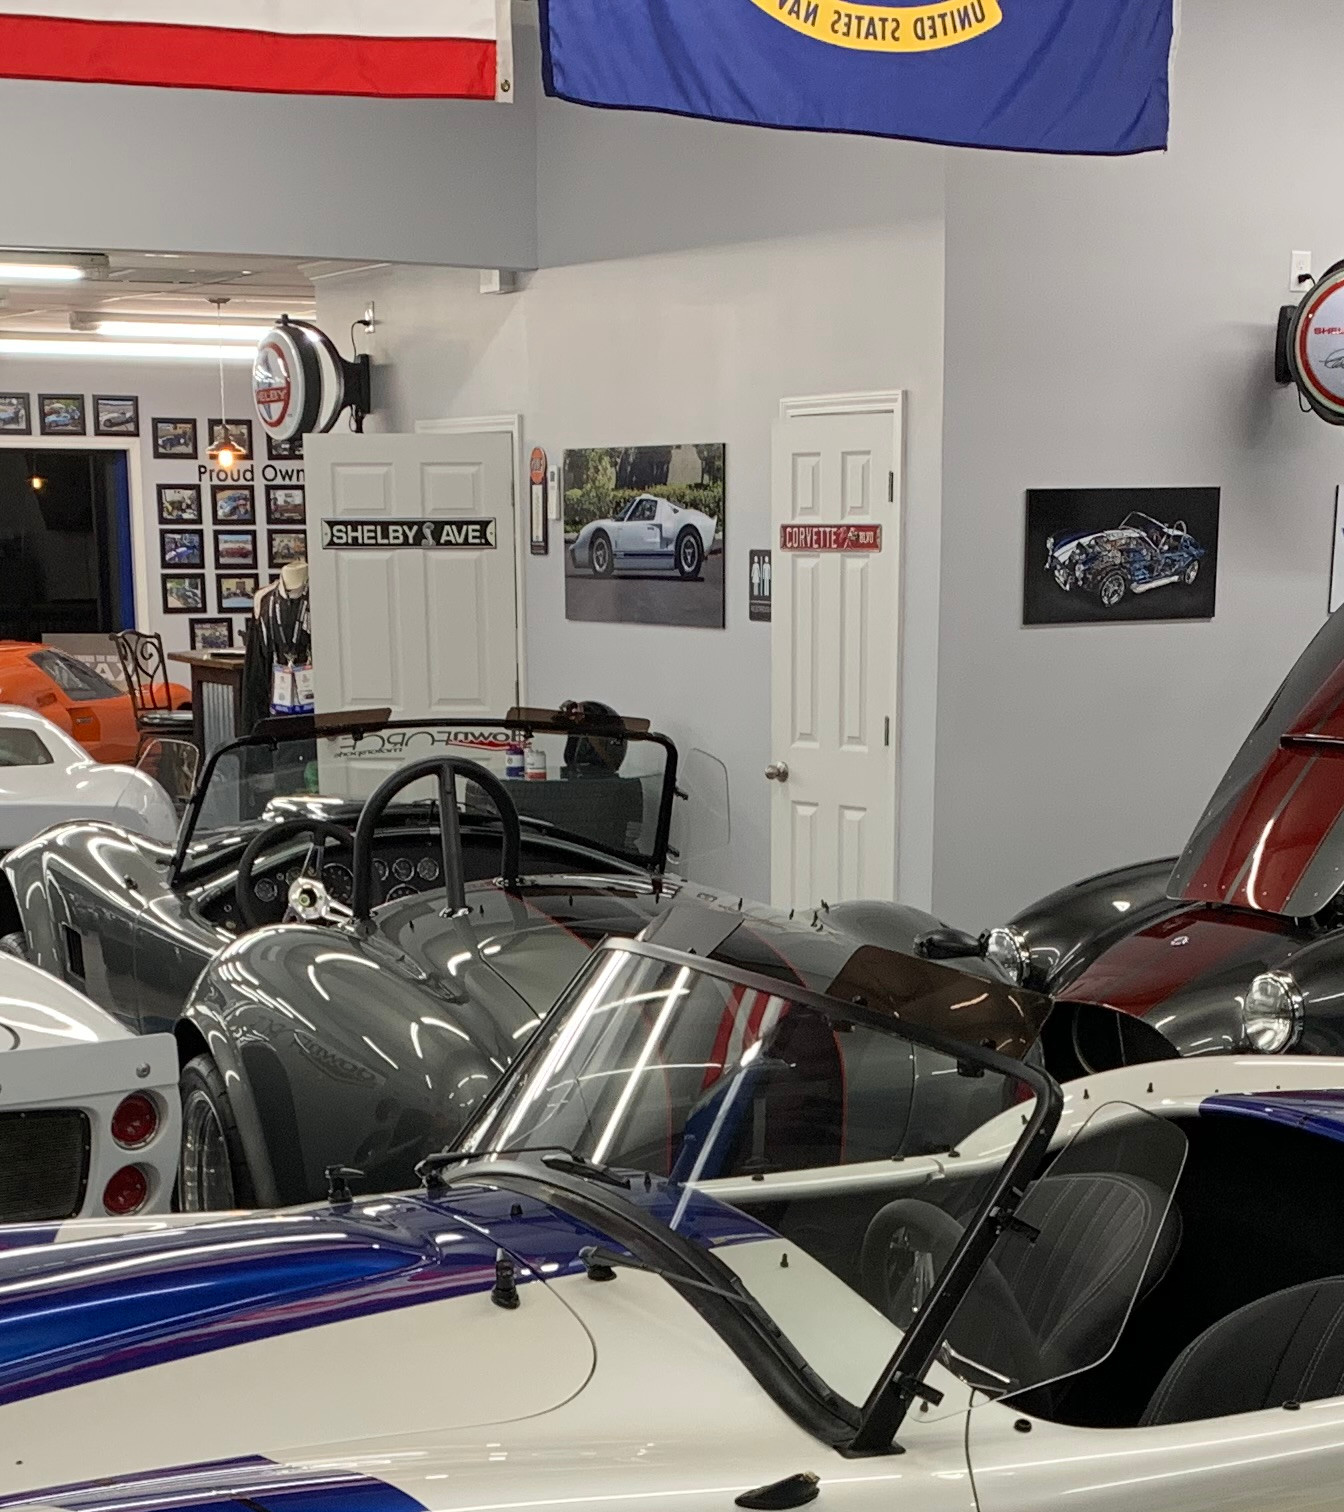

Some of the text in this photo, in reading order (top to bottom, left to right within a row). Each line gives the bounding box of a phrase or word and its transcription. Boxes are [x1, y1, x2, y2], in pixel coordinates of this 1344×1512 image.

[198, 464, 254, 482] Proud
[332, 524, 485, 544] SHELBY AVE.
[786, 527, 837, 549] CORVETTE
